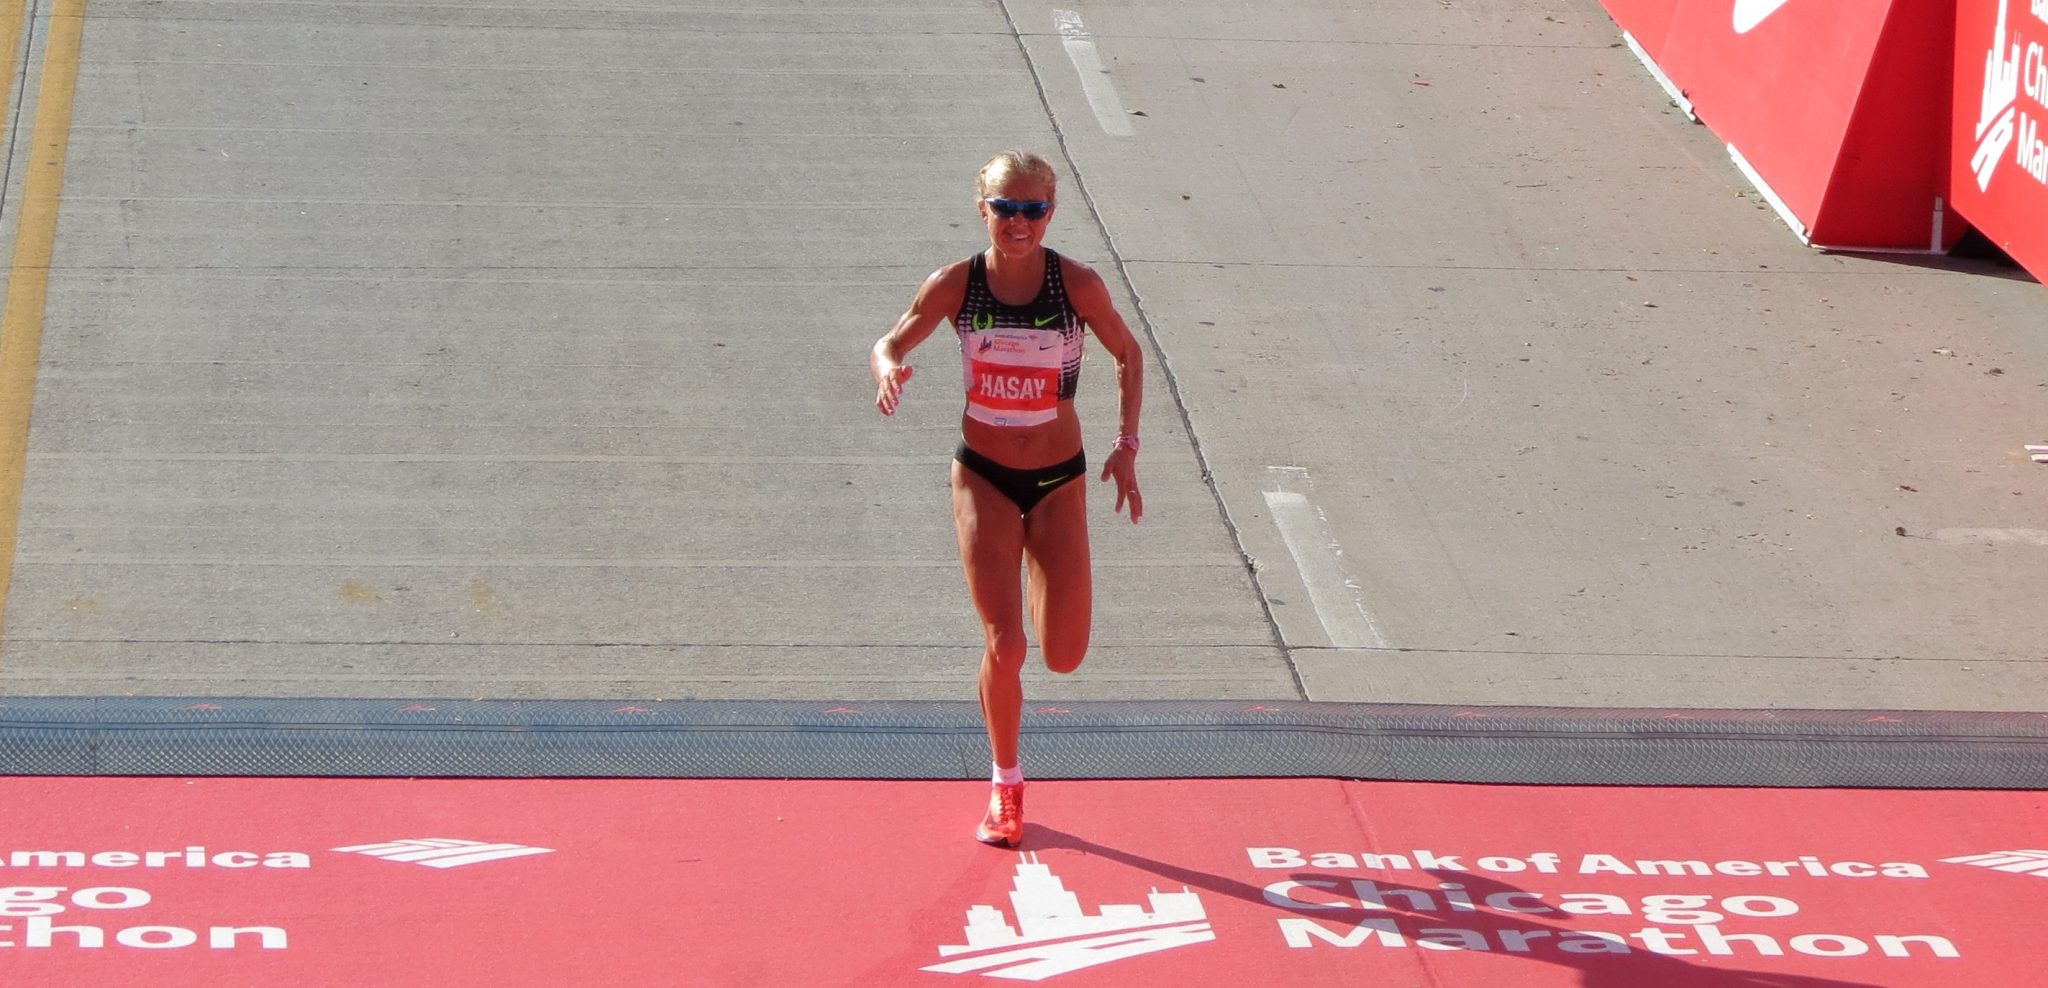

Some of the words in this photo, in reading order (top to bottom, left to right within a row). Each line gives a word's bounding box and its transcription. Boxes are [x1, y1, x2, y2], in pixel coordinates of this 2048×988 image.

[980, 373, 1045, 400] HASAY
[0, 846, 310, 868] merica
[1246, 847, 1467, 871] Bank
[1477, 853, 1560, 873] of
[1578, 854, 1930, 879] America
[1262, 880, 1800, 925] Chicago
[1276, 918, 1961, 958] Marathon
